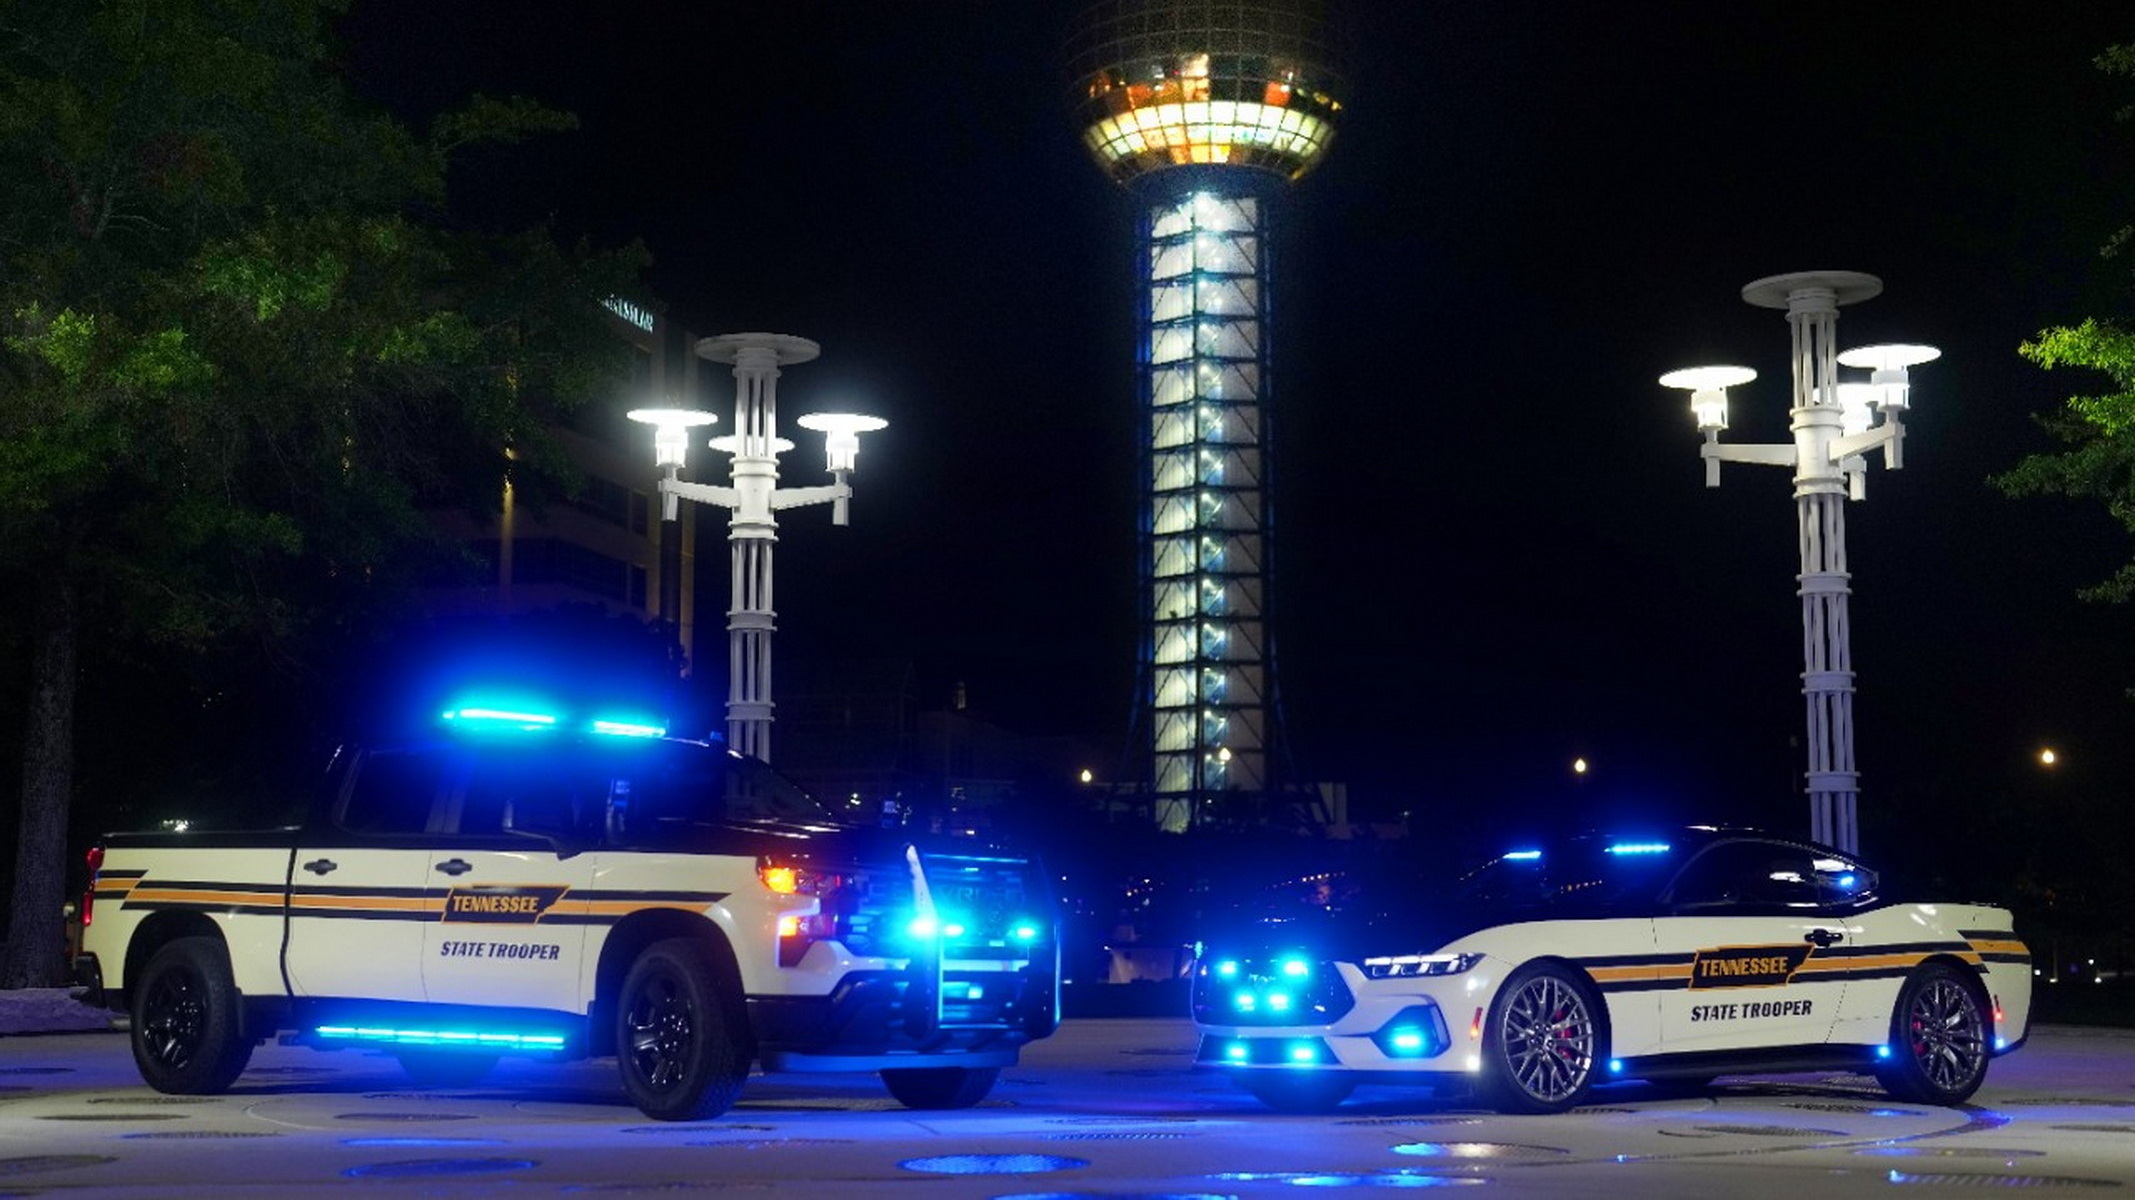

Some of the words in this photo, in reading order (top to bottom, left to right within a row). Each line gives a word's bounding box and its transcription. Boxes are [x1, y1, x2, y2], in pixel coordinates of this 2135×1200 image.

[453, 895, 541, 913] TENNESSEE
[441, 941, 486, 957] STATE
[488, 943, 560, 960] TROOPER
[1701, 956, 1788, 977] TENNESSEE
[1691, 1004, 1738, 1022] STATE
[1742, 1000, 1812, 1019] TROOPER
